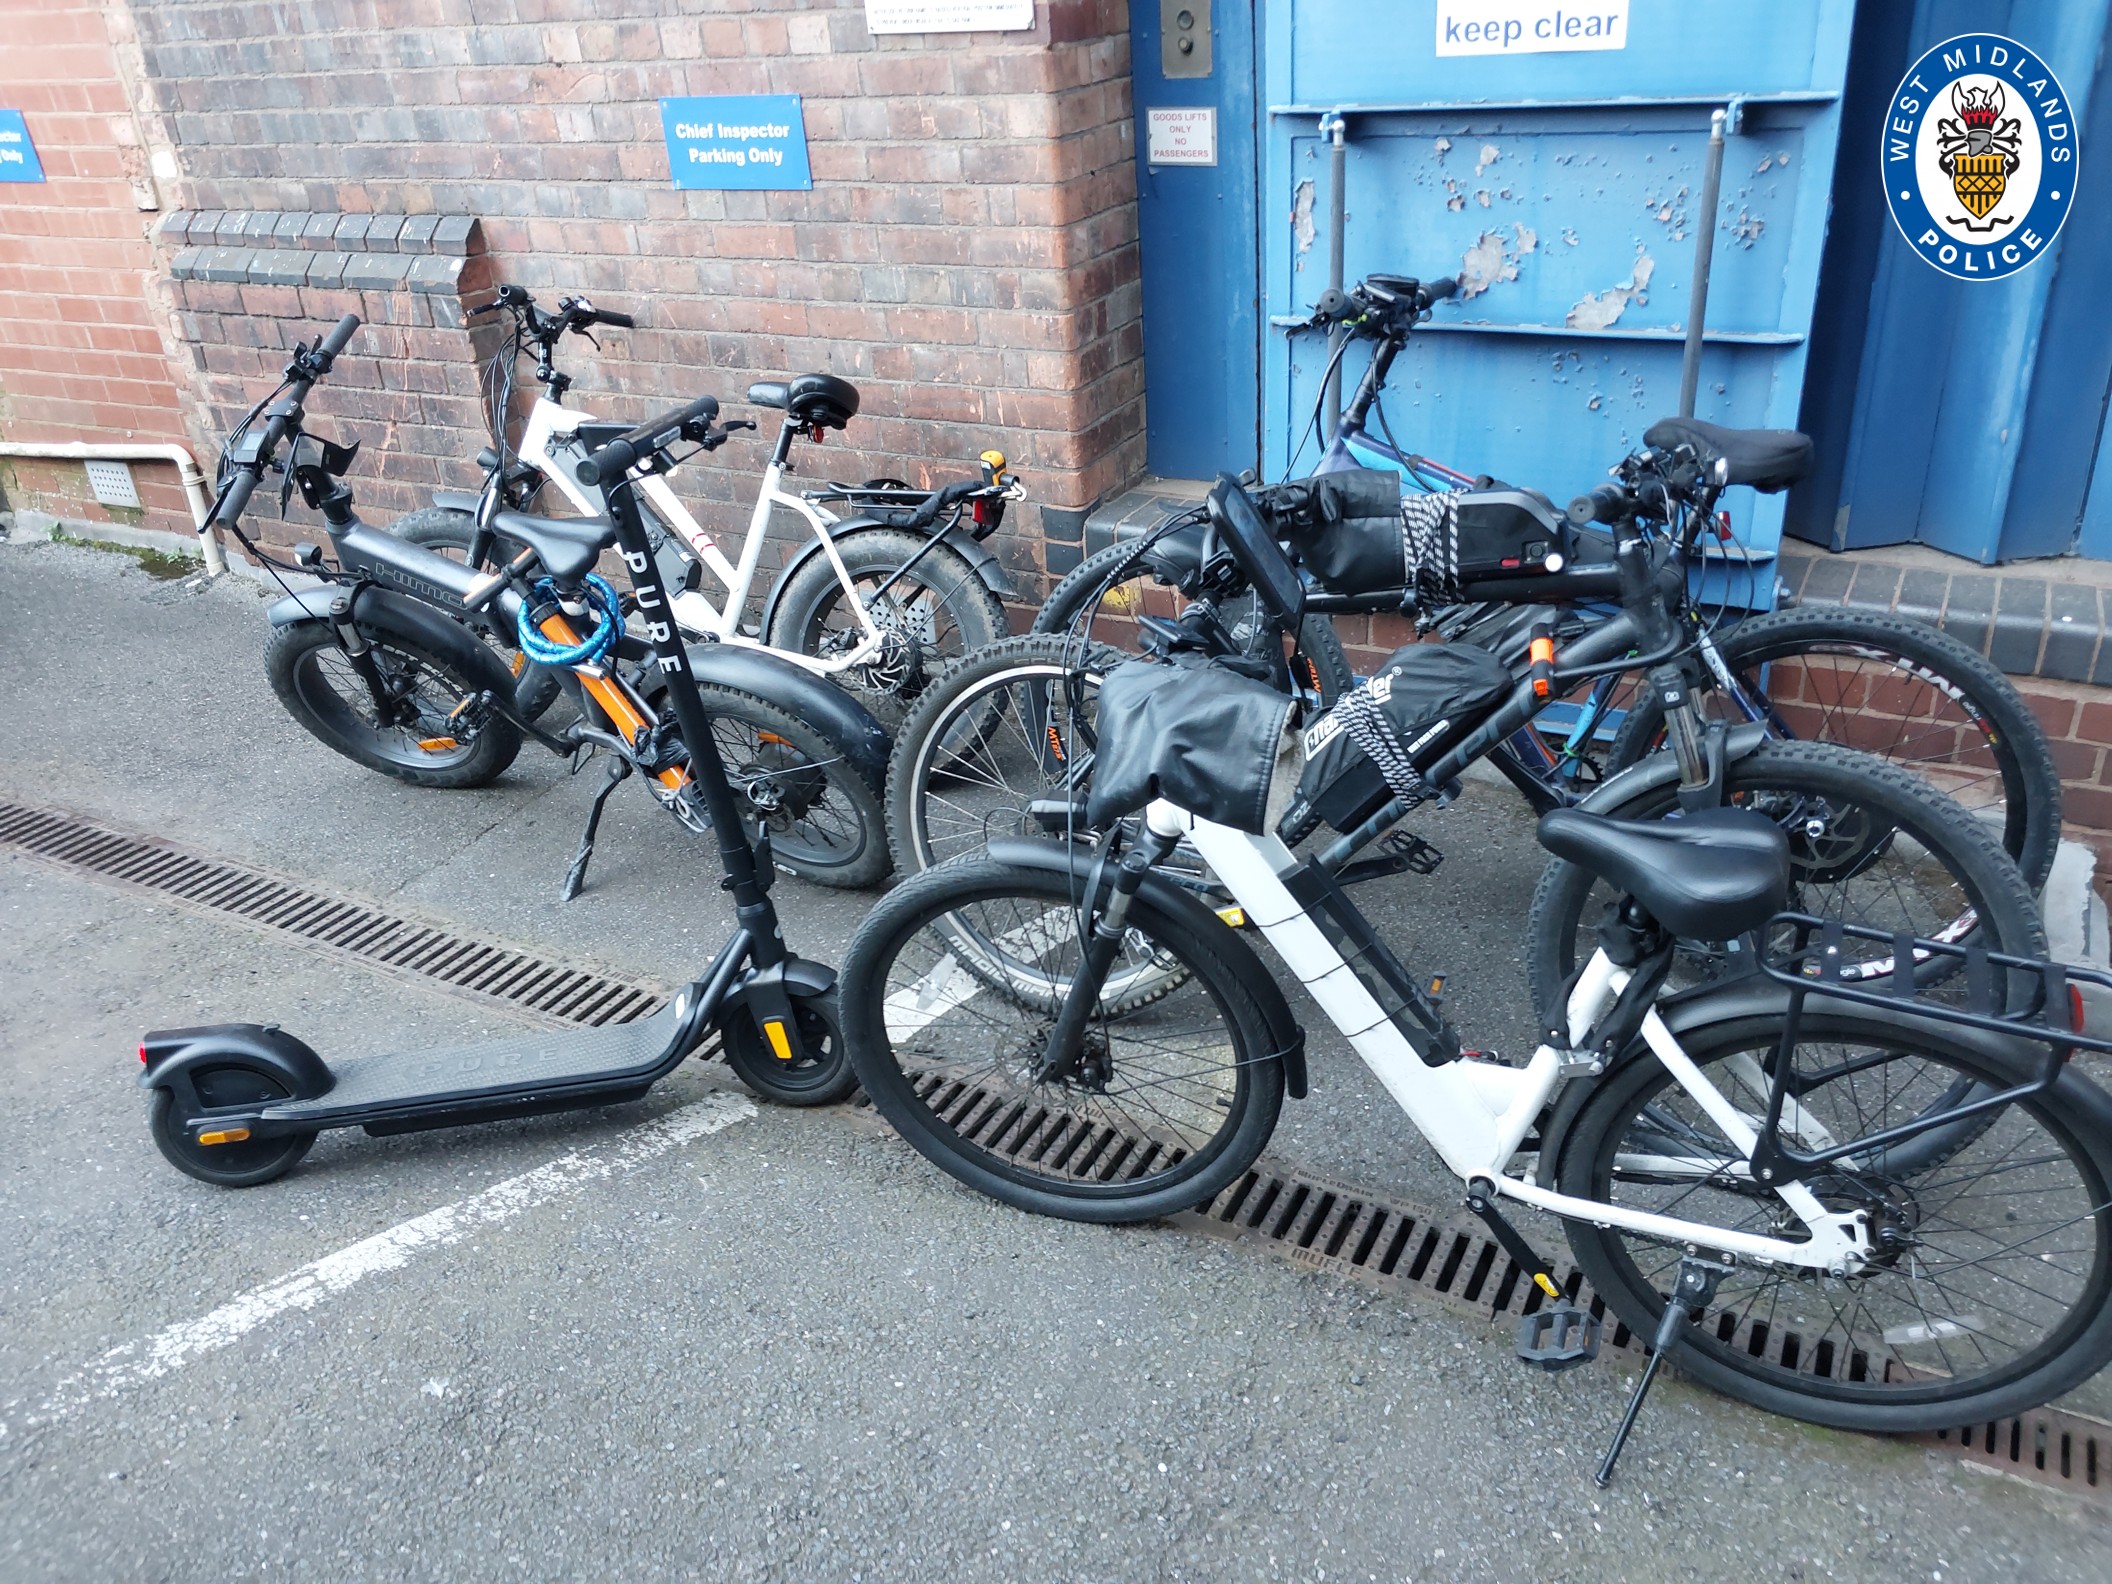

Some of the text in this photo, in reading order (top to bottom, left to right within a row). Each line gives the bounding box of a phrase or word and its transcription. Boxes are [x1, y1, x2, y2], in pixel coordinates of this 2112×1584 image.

[1445, 10, 1619, 47] keep clear
[1153, 112, 1207, 121] GOODS LIFTS
[675, 122, 790, 141] Chief Inspector
[1169, 125, 1191, 133] ONLY
[1174, 137, 1187, 145] NO
[688, 147, 783, 167] Parking Only
[1154, 149, 1209, 158] PASSENGERS
[623, 550, 682, 675] PURE
[418, 1049, 558, 1078] PURE
